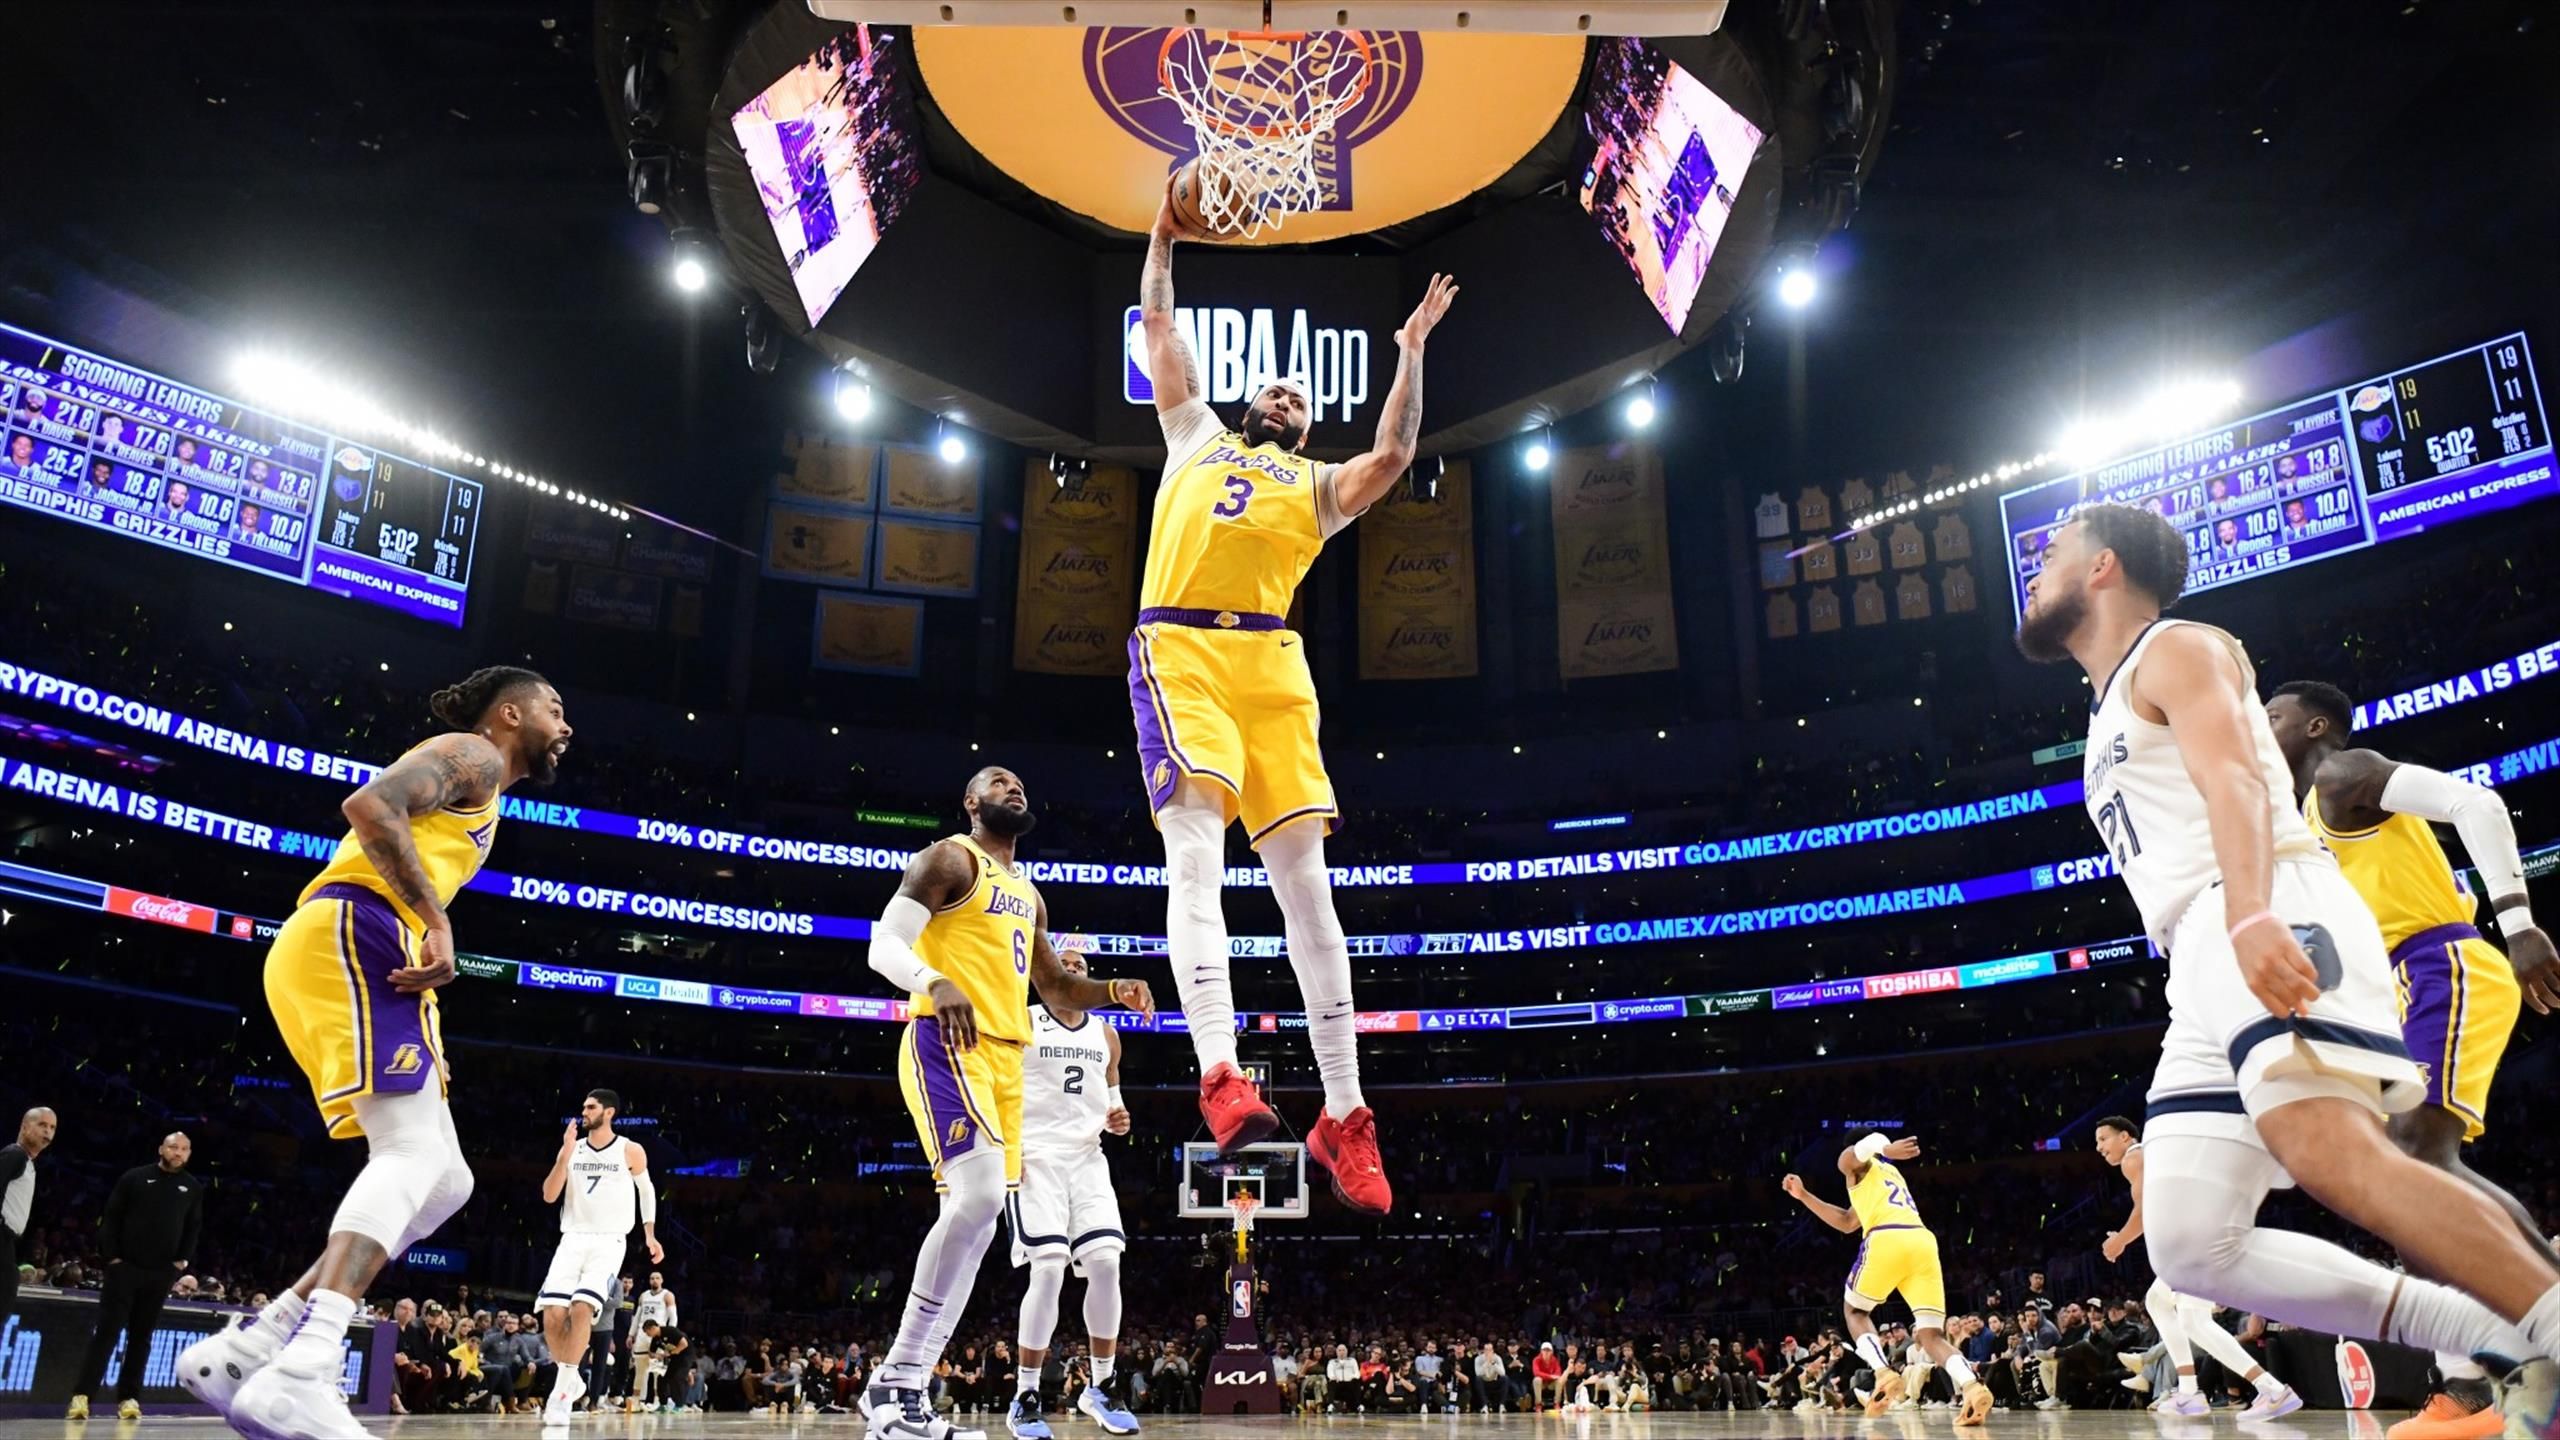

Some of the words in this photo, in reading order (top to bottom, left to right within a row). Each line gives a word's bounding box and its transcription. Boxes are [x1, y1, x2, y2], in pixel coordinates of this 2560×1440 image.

[1174, 308, 1278, 403] NBA
[1286, 309, 1368, 422] App
[2496, 345, 2518, 370] 19
[61, 354, 146, 398] SCORING
[146, 381, 224, 424] LEADERS
[2399, 378, 2417, 400] 19
[2504, 377, 2522, 401] 11
[0, 360, 50, 386] LOS
[52, 381, 171, 424] ANGELES
[173, 418, 272, 456] LAKERS
[54, 401, 95, 431] 21.8
[2405, 408, 2421, 430] 11
[41, 422, 76, 442] DAVIS
[2294, 410, 2337, 432] PLAYOFFS
[134, 426, 170, 455] 17.6
[280, 437, 320, 458] PLAYOFFS
[2426, 426, 2477, 463] 5:02
[43, 447, 85, 478] 25.2
[116, 445, 157, 466] REAVES
[208, 449, 242, 477] 16.2
[1195, 446, 1299, 484] LAKERS
[2098, 456, 2166, 492] SCORING
[2168, 431, 2235, 469] LEADERS
[2200, 438, 2291, 475] LAKERS
[2306, 444, 2340, 474] 13.8
[2437, 456, 2470, 474] QUARTER
[31, 469, 63, 487] BANE
[181, 464, 239, 492] HACHIMURA
[378, 461, 392, 482] 19
[2237, 466, 2269, 490] 16.2
[2297, 470, 2335, 493] RUSSELL
[123, 470, 161, 500] 18.8
[278, 471, 311, 499] 13.8
[1213, 475, 1254, 519] 3
[2378, 490, 2466, 524] AMERICAN
[2469, 466, 2551, 499] EXPRESS
[93, 487, 138, 511] JACKSON
[198, 492, 234, 521] 10.6
[262, 488, 299, 510] RUSSELL
[373, 490, 385, 510] 11
[457, 487, 472, 509] 19
[2171, 485, 2202, 511] 17.6
[2220, 487, 2273, 512] HACHIMURA
[2315, 489, 2349, 517] 10.0
[113, 510, 232, 557] GRIZZLIES
[181, 513, 220, 534] BROOKS
[270, 514, 303, 543] 10.0
[453, 515, 465, 536] 11
[2246, 508, 2278, 536] 10.6
[2306, 514, 2346, 537] TILLMAN
[379, 523, 419, 557] 5:02
[2237, 536, 2273, 556] BROOKS
[380, 549, 408, 565] QUARTER
[1045, 552, 1110, 577] LAKERS
[1385, 553, 1450, 576] LAKERS
[2187, 546, 2291, 588] GRIZZLIES
[316, 561, 393, 592] AMERICAN
[395, 583, 459, 611] EXPRESS
[1041, 623, 1107, 648] LAKERS
[1386, 627, 1453, 650] LAKERS
[1585, 622, 1653, 646] LAKERS
[2375, 675, 2478, 725] ARENA
[2481, 662, 2513, 693] IS
[174, 717, 269, 764] ARENA
[275, 745, 305, 771] IS
[10, 762, 120, 813] ARENA
[126, 791, 158, 821] IS
[163, 801, 273, 850] BETTER
[1554, 820, 1591, 829] AMERICAN
[1593, 816, 1626, 826] EXPRESS
[636, 819, 693, 847] 10%
[698, 829, 745, 853] OFF
[1466, 862, 1513, 883] FOR
[1517, 852, 1613, 880] DETAILS
[1617, 846, 1681, 872] VISIT
[1684, 789, 2048, 865] GO.AMEX/CRYPTOCOMARENA
[131, 895, 193, 925] Coca-Cola
[510, 876, 570, 905] 10%
[576, 886, 627, 911] OFF
[631, 893, 814, 935] CONCESSIONS
[1467, 930, 1524, 953] AILS
[1527, 925, 1591, 949] VISIT
[1595, 884, 1965, 945] GO.AMEX/CRYPTOCOMARENA
[1013, 929, 1026, 974] 6
[1110, 937, 1130, 953] 19
[1355, 939, 1374, 954] 11
[1433, 941, 1441, 952] 2
[1452, 941, 1459, 952] 6
[2089, 945, 2133, 961] TOYOTA
[530, 966, 604, 989] Spectrum
[1869, 970, 1955, 995] TOSHIBA
[628, 980, 656, 995] UCLA
[664, 984, 705, 1001] Health
[735, 993, 792, 1008] crypto.com
[1823, 984, 1860, 999] ULTRA
[1444, 1012, 1502, 1027] DELTA
[1619, 1002, 1674, 1016] crypto.com
[1039, 1045, 1104, 1063] MEMPHIS
[1064, 1065, 1084, 1095] 2
[573, 1162, 620, 1173] MEMPHIS
[587, 1175, 602, 1194] 7
[408, 1252, 447, 1266] ULTRA
[643, 1305, 655, 1315] 24
[1224, 1342, 1244, 1351] Google
[1214, 1370, 1267, 1386] KIA
